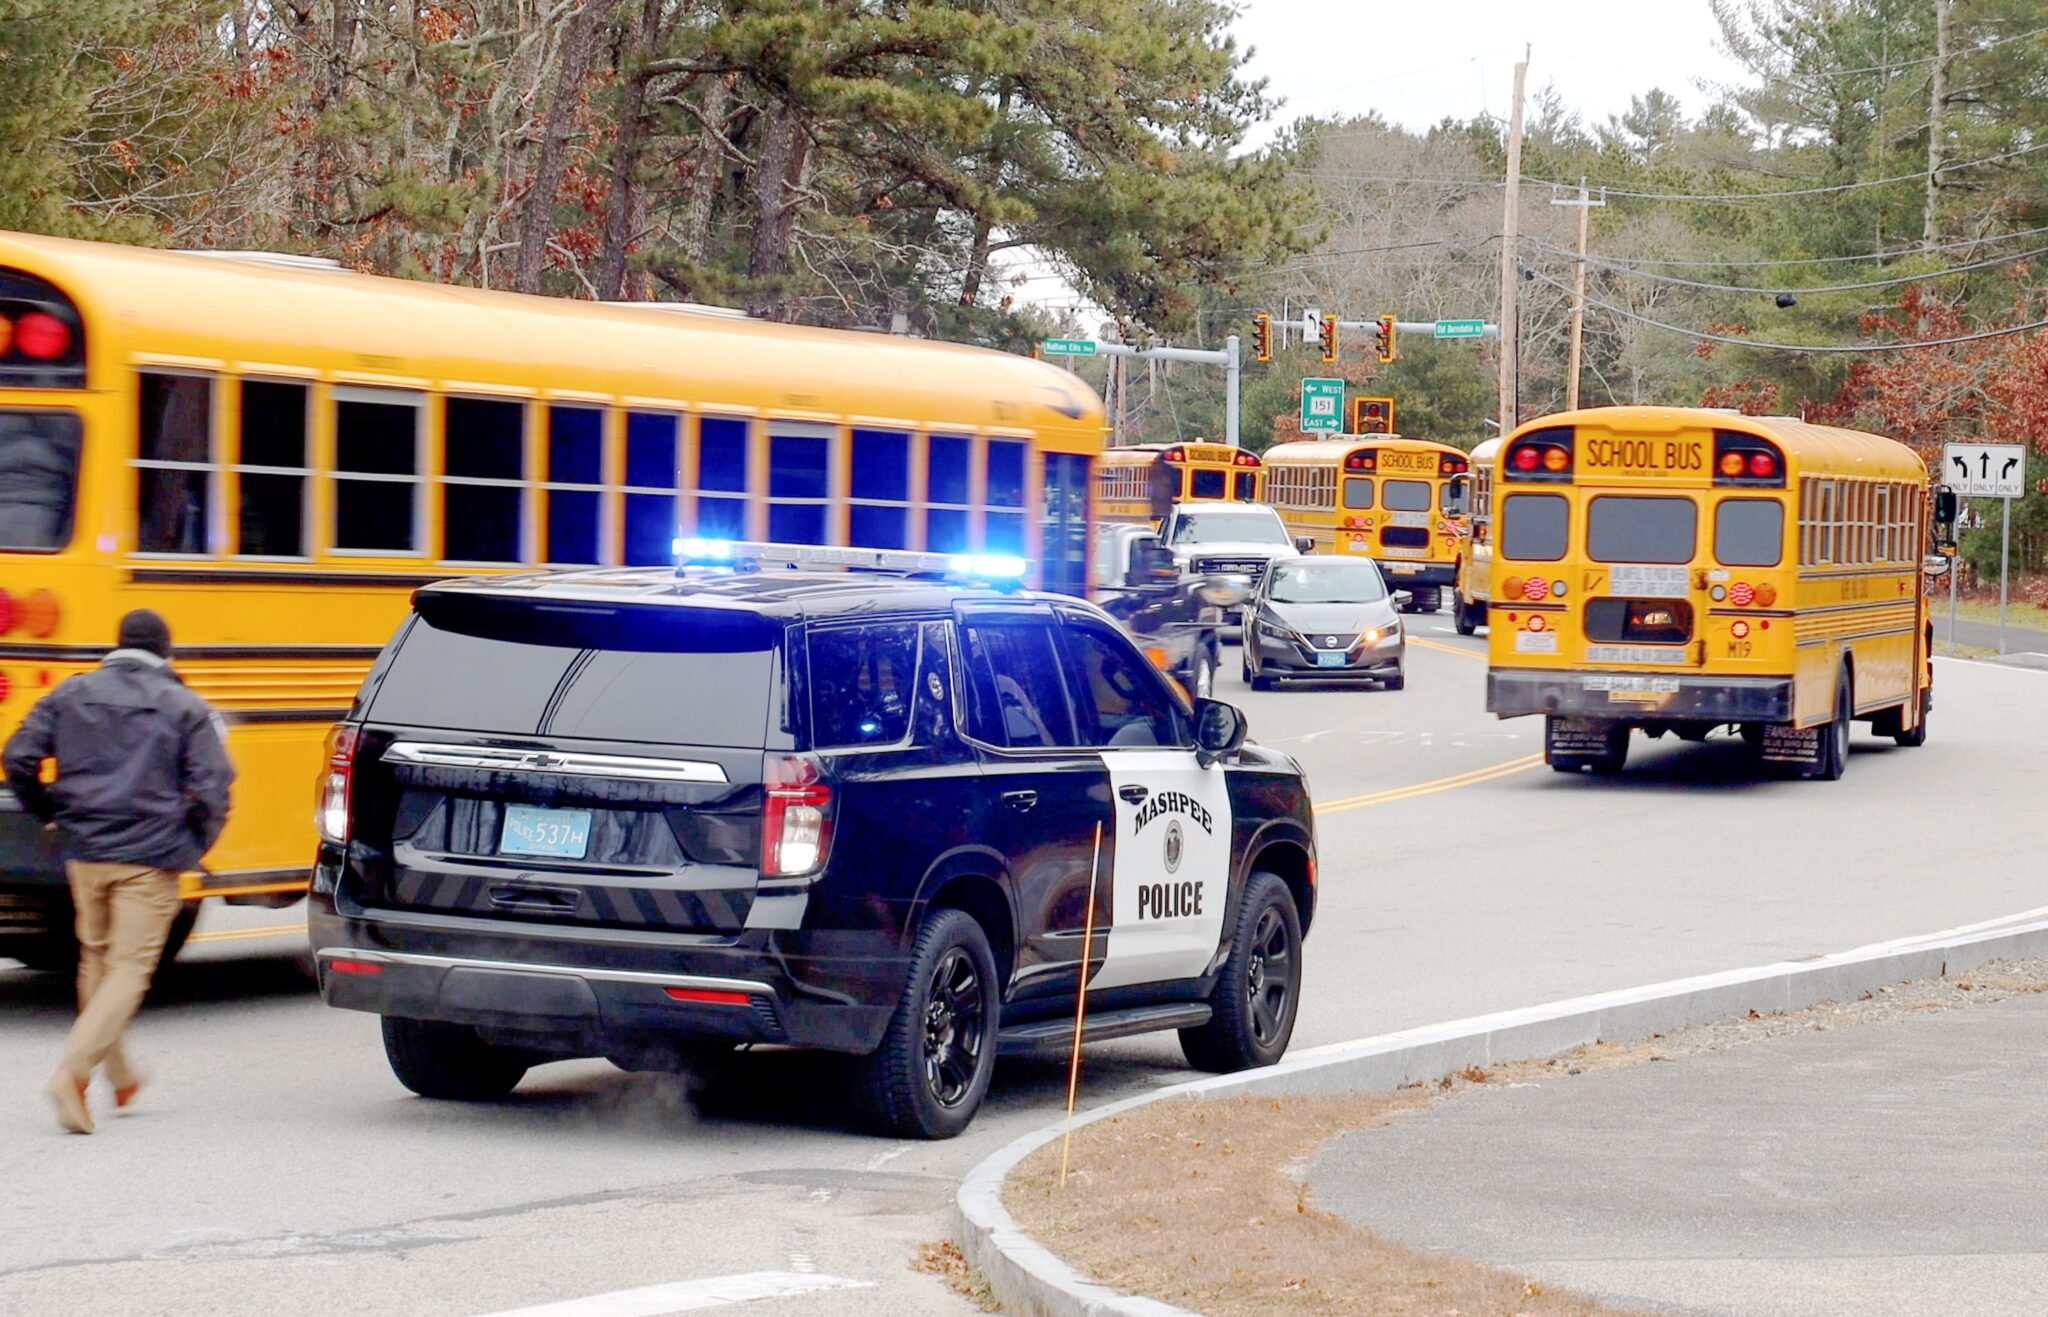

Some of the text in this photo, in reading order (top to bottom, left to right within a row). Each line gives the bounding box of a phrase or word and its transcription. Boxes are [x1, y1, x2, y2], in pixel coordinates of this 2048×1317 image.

[1322, 385, 1342, 394] WEST
[1315, 401, 1331, 411] 151
[1303, 418, 1324, 427] EAST
[1189, 449, 1231, 462] SCHOOL BUS
[1382, 453, 1434, 470] SCHOOL BUS
[1587, 439, 1703, 470] SCHOOL BUS
[1972, 483, 1994, 492] ONLY
[1998, 484, 2020, 493] ONLY
[1221, 564, 1257, 573] GMC
[1728, 641, 1751, 659] M19
[1134, 792, 1213, 835] MASHPEE
[535, 822, 585, 846] 537H
[1138, 881, 1204, 920] POLICE
